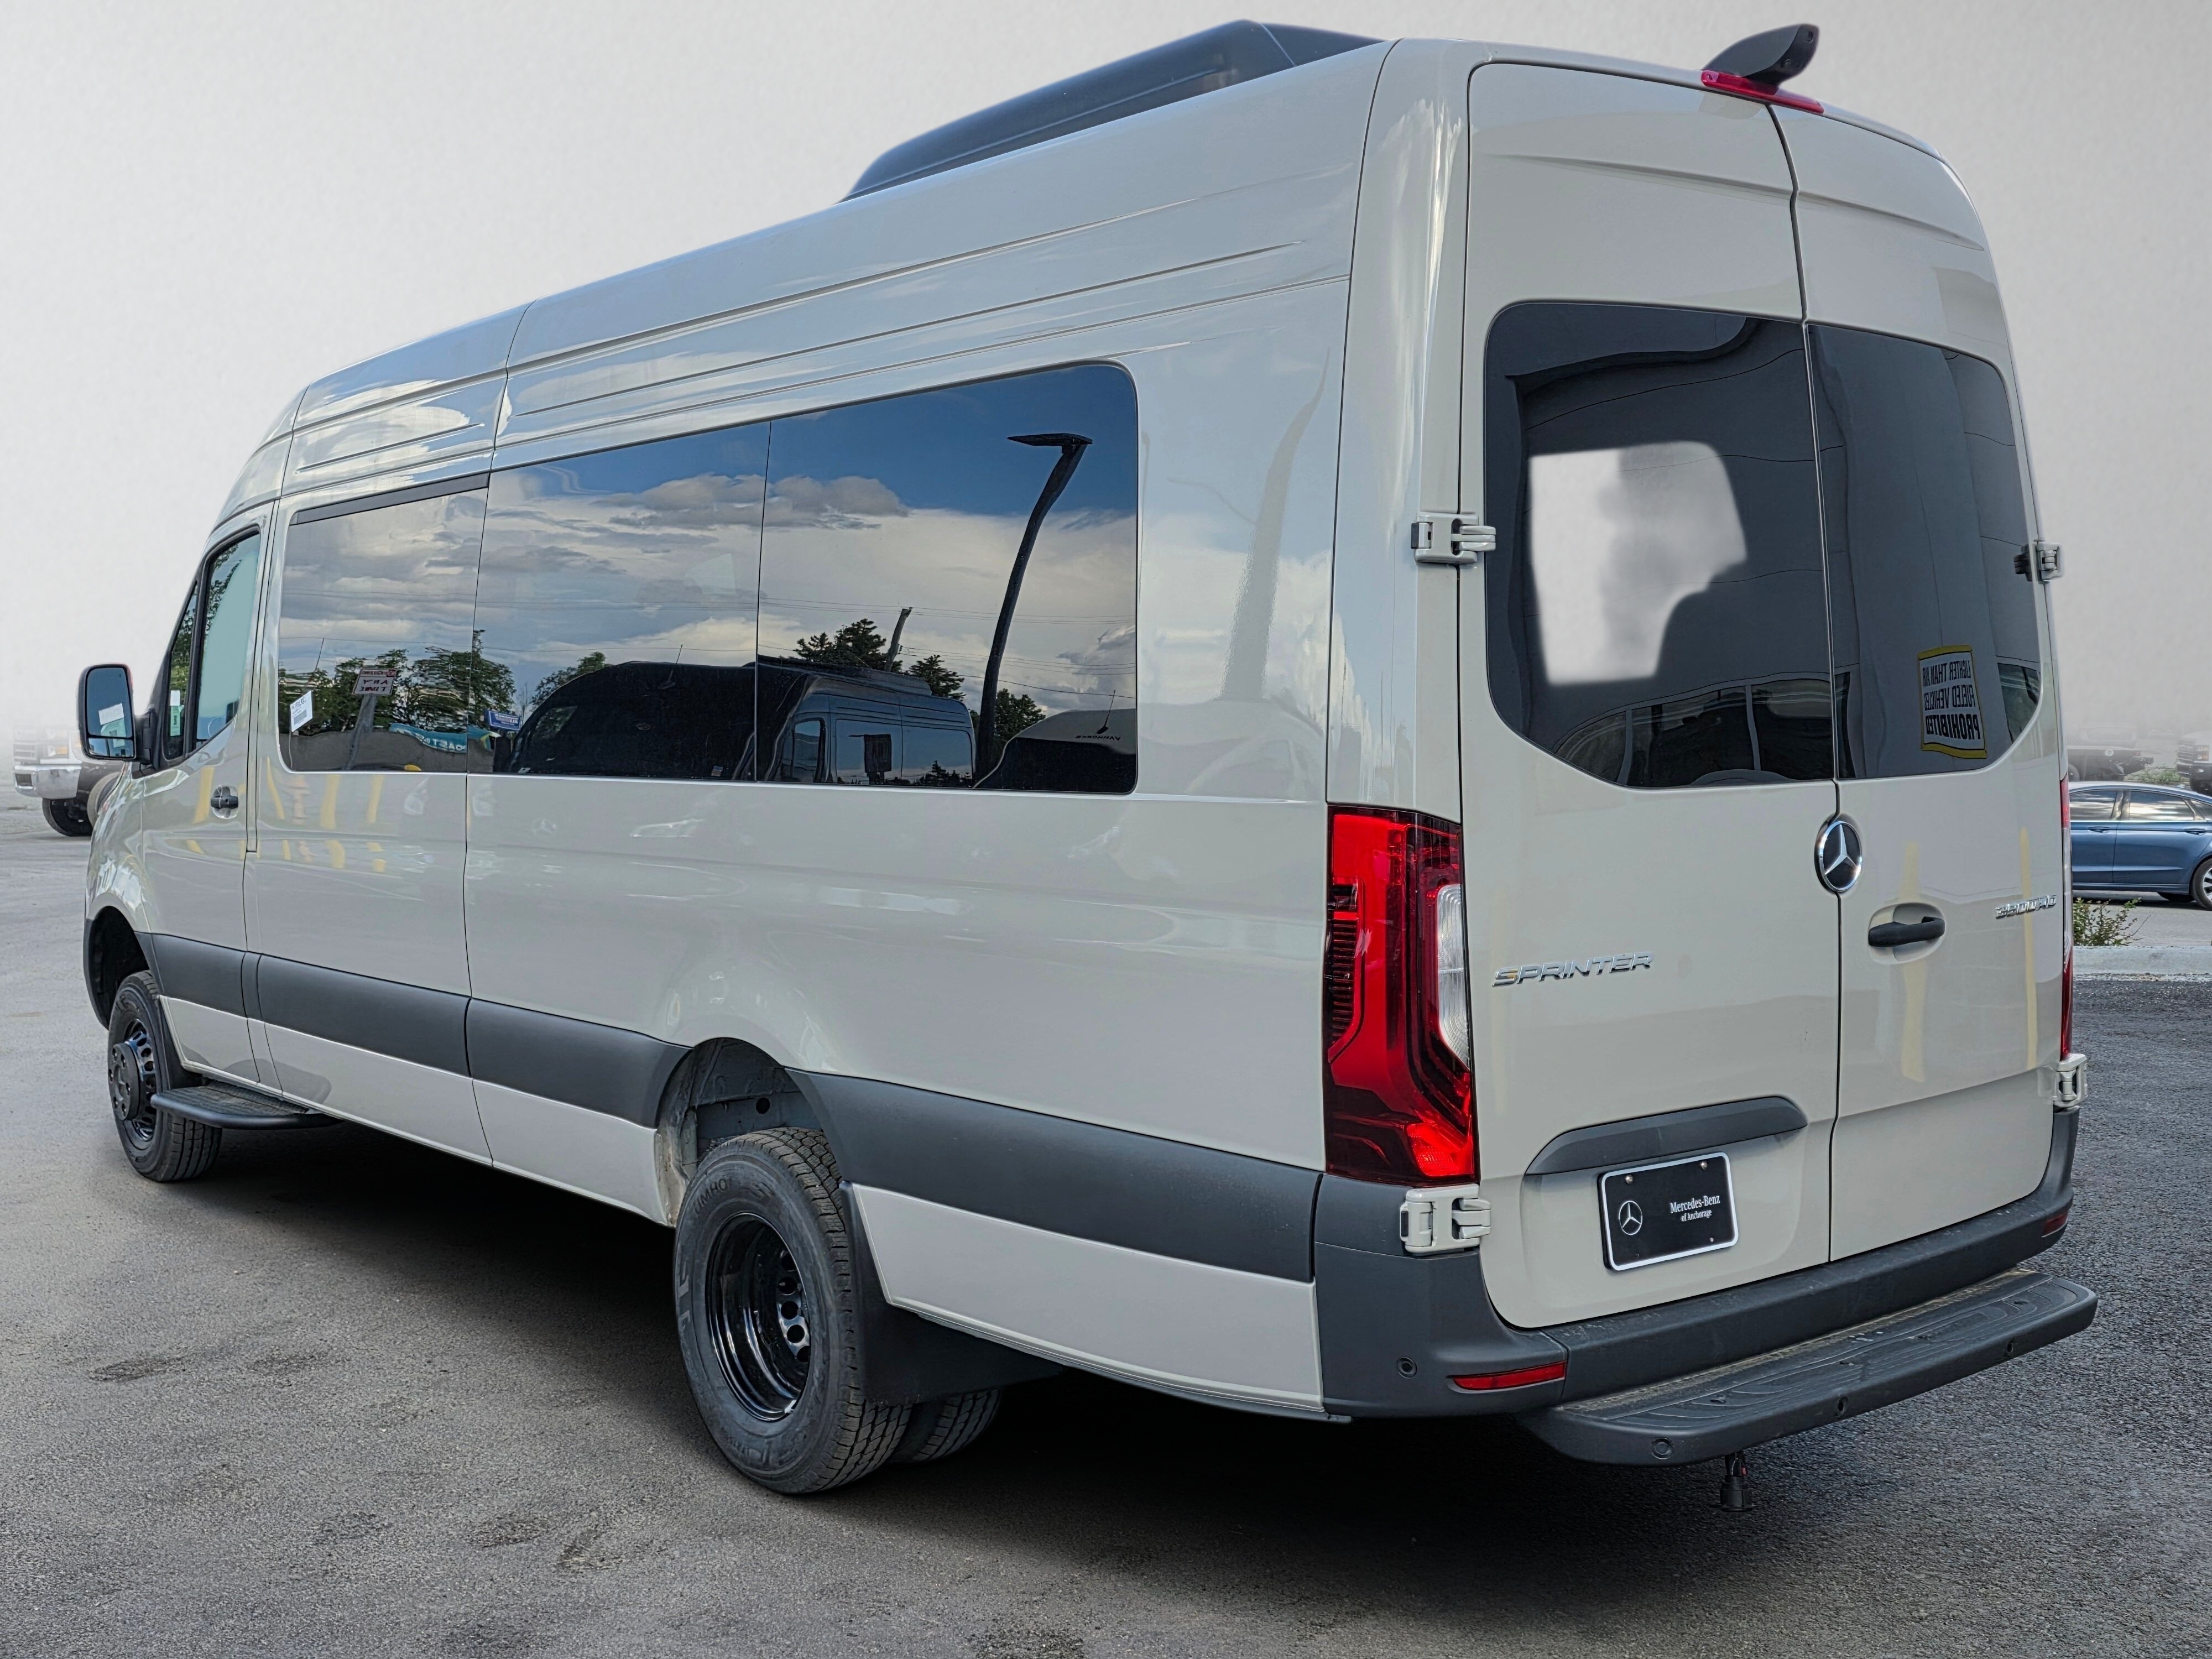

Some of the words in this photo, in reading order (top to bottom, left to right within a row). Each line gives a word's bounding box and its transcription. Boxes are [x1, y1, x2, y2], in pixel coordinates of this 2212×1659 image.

[1492, 951, 1655, 987] SPRINTER
[1670, 1195, 1720, 1213] Mercedes-Benz
[1681, 1213, 1687, 1222] of
[1687, 1209, 1712, 1220] Anchorage
